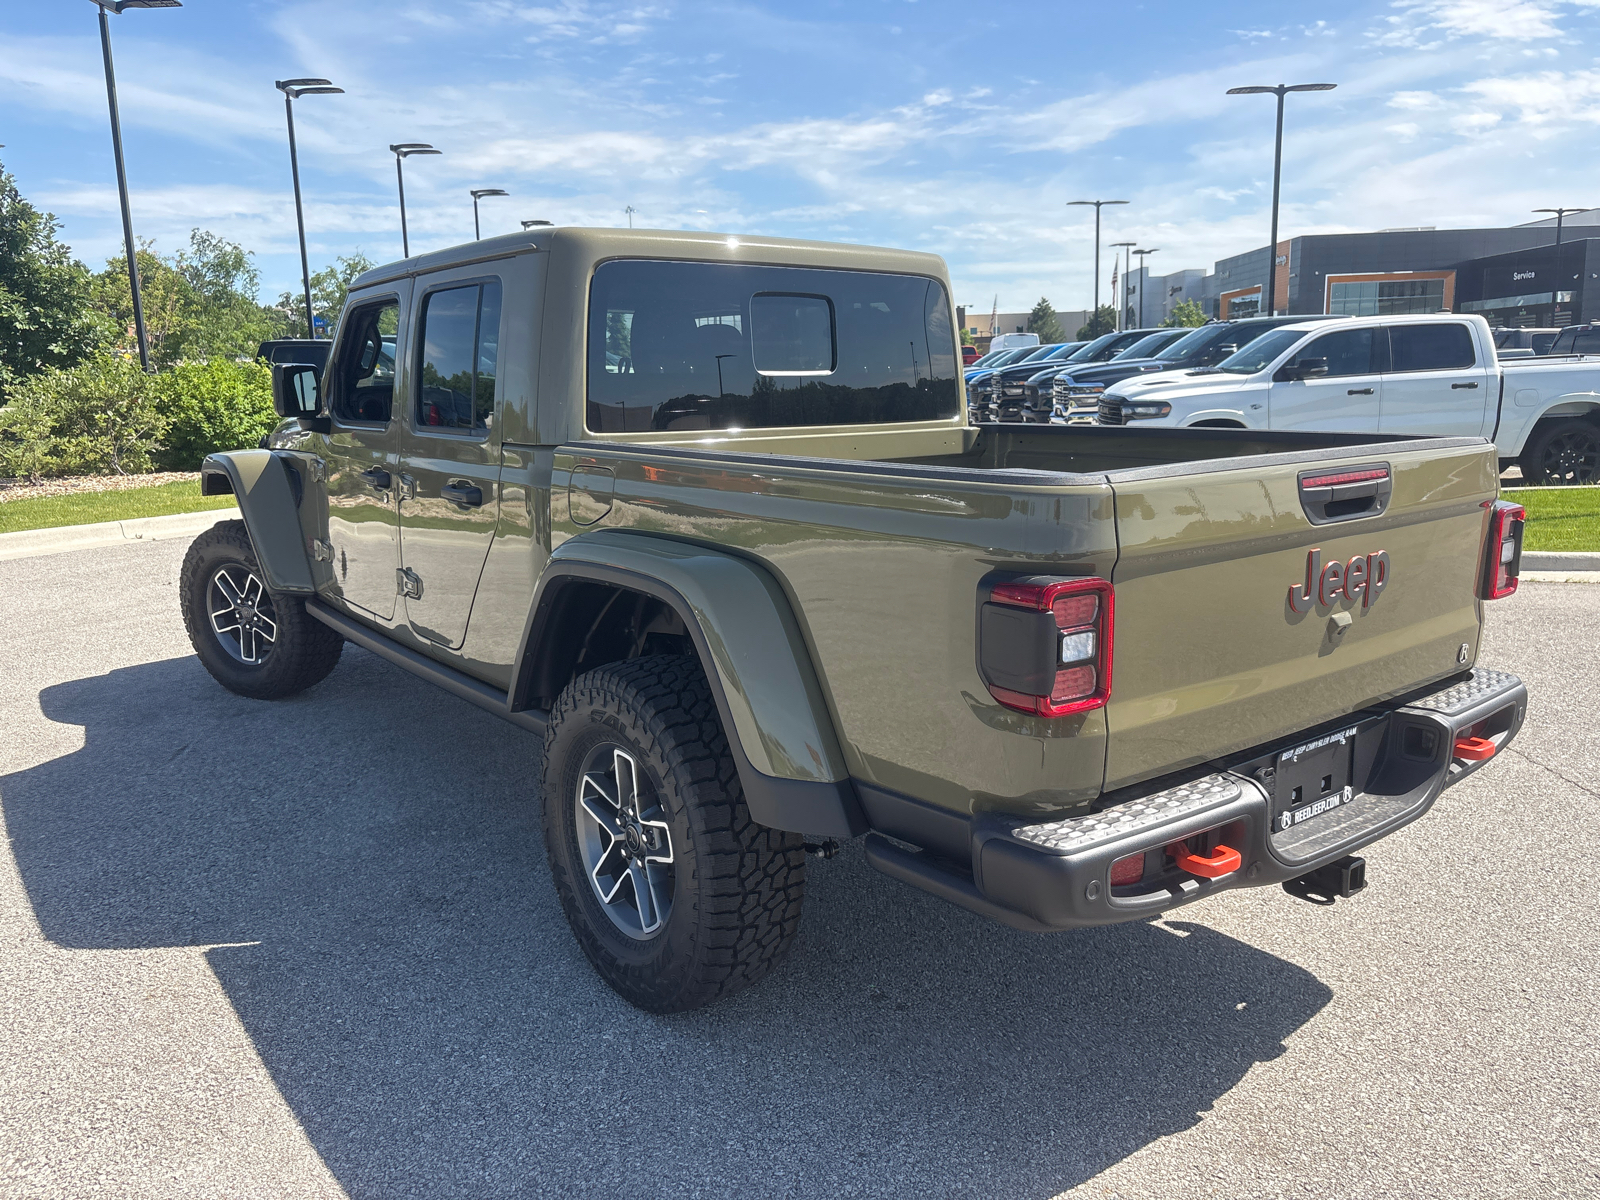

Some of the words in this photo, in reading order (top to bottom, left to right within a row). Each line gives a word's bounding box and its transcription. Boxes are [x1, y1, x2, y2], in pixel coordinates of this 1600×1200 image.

[1513, 270, 1535, 281] Service
[1289, 548, 1390, 613] Jeep
[1306, 737, 1330, 751] CHRYSLER
[1345, 726, 1358, 738] RAM
[1294, 794, 1340, 824] REEDJEEP.COM
